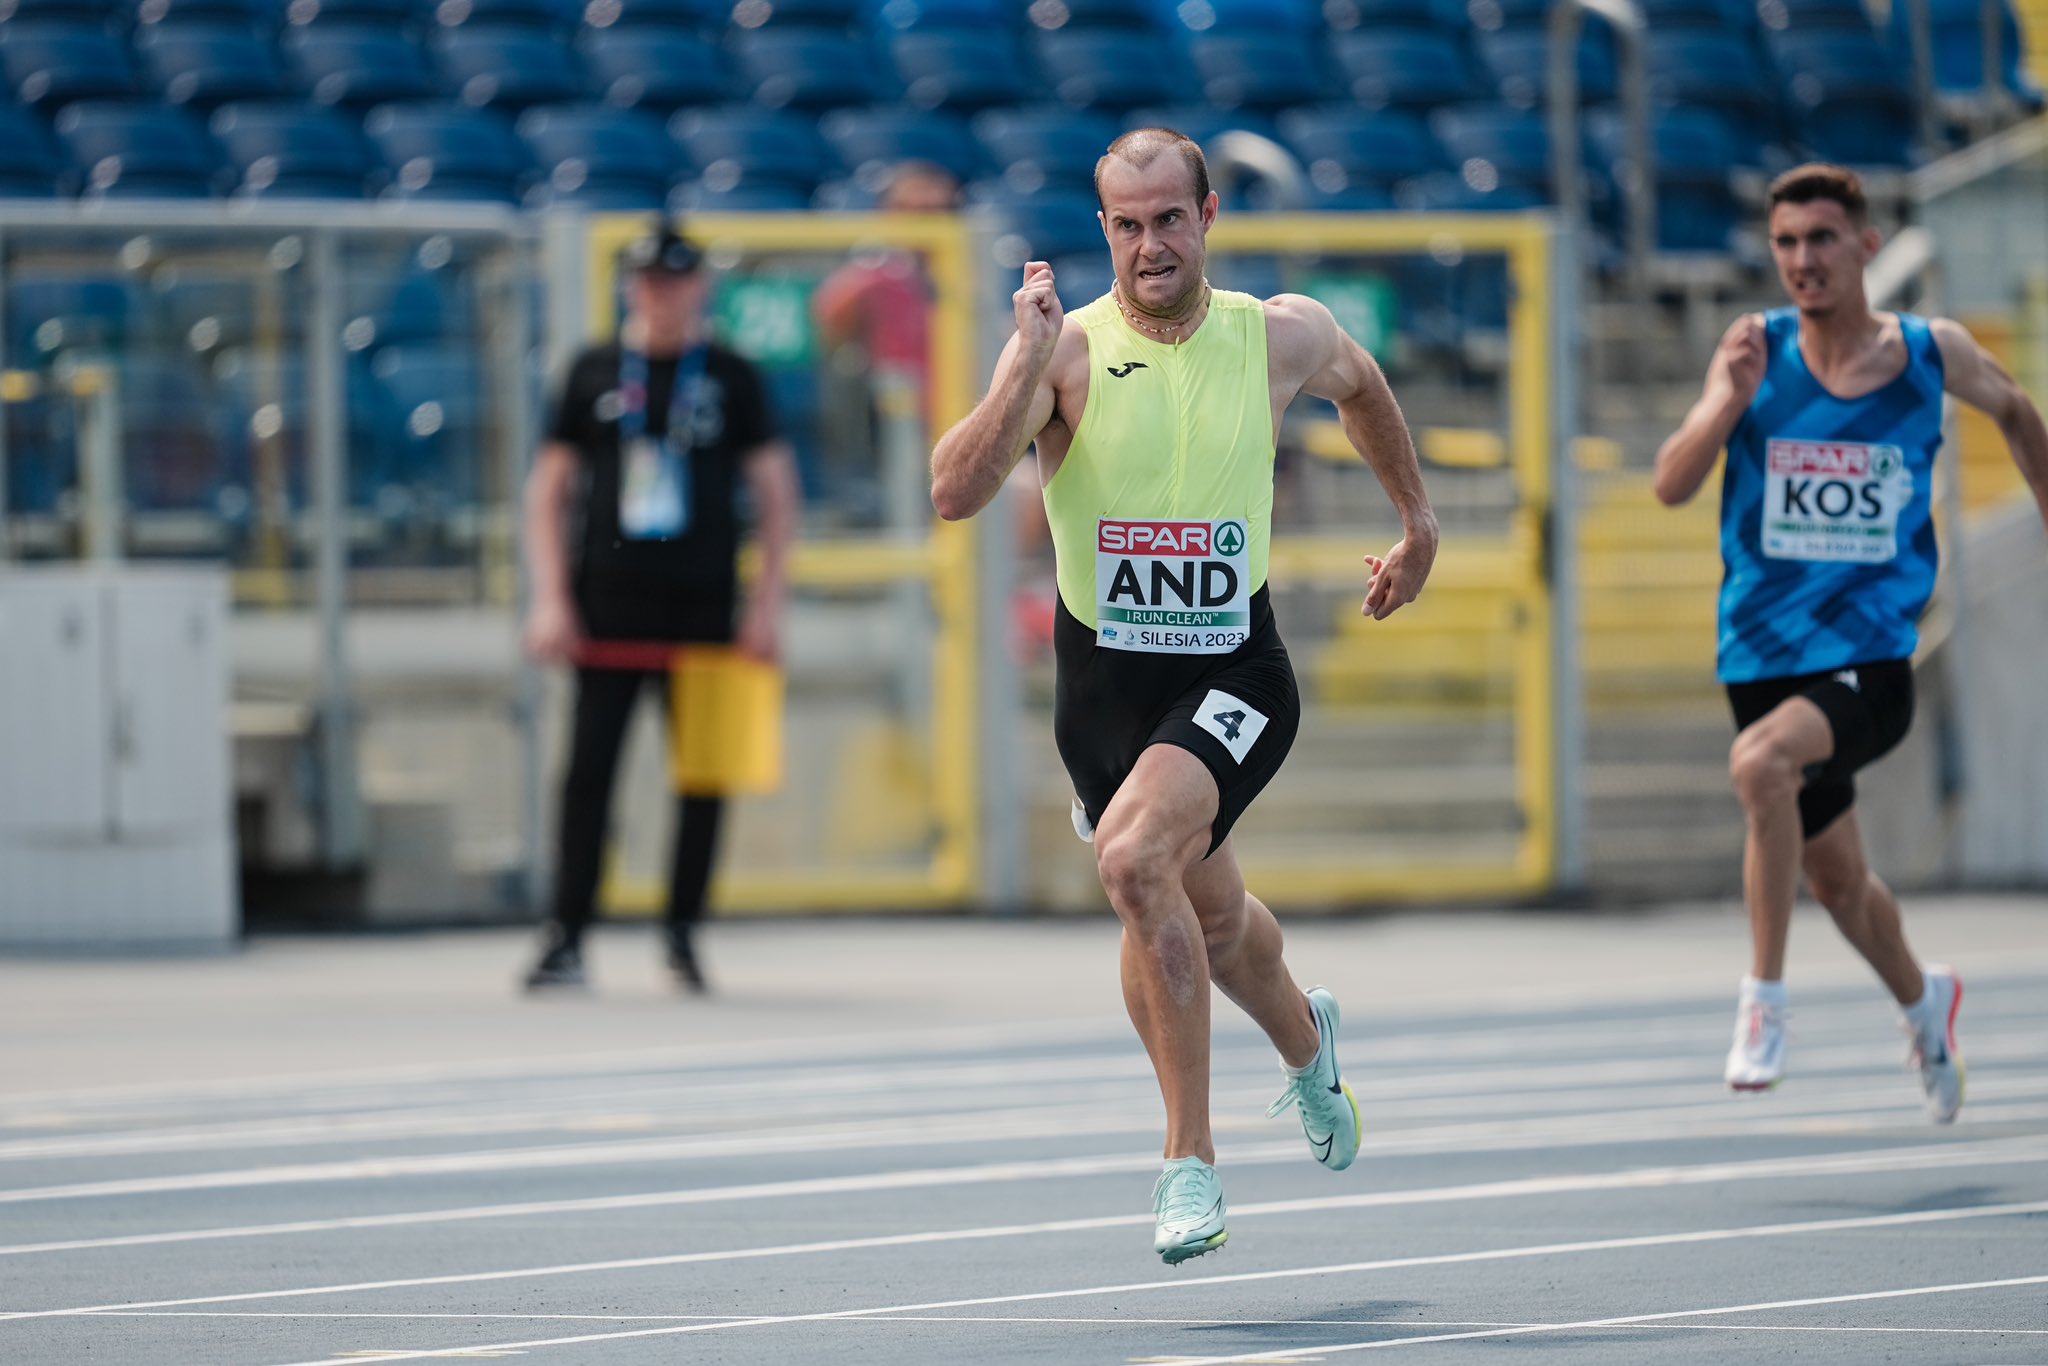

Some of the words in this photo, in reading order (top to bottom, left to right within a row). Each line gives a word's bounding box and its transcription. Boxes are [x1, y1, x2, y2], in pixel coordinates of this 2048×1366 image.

[1784, 478, 1883, 519] KOS
[1101, 525, 1208, 551] SPAR
[1106, 559, 1238, 608] AND
[1133, 611, 1164, 624] RUN
[1140, 631, 1202, 647] SILESIA
[1205, 632, 1245, 647] 2023
[1213, 709, 1247, 743] 4
